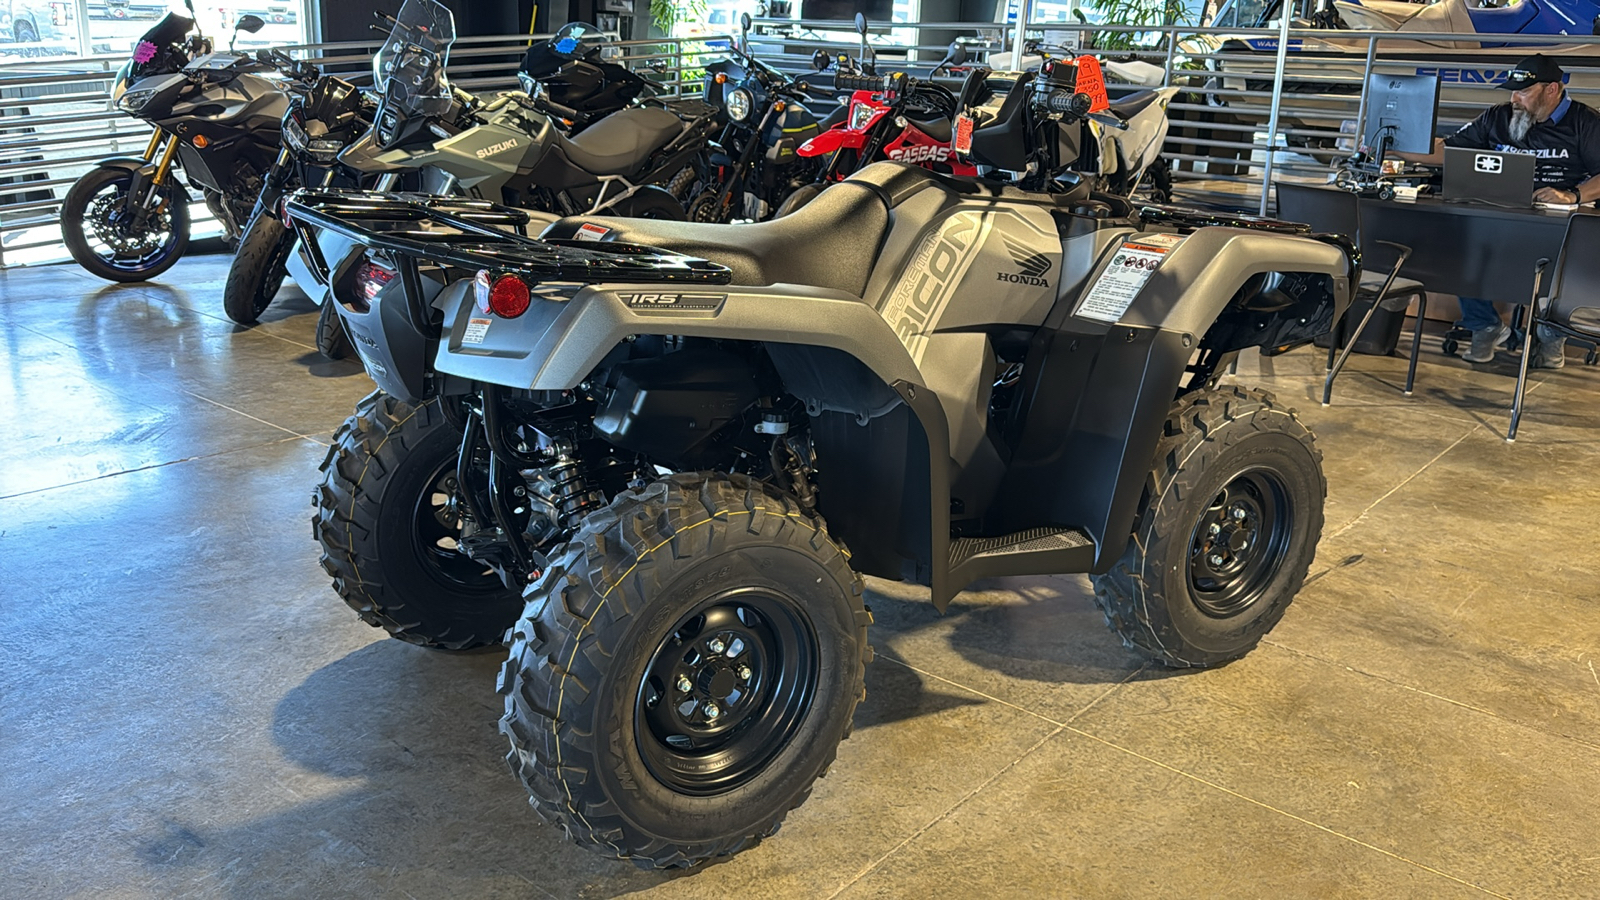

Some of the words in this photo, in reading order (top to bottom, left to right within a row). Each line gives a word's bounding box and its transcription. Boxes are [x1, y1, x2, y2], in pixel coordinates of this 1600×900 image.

[475, 138, 519, 159] SUZUKI
[889, 145, 951, 164] GASGAS
[887, 225, 943, 325] FOREMAN
[996, 272, 1050, 288] HONDA
[630, 294, 679, 304] IRS
